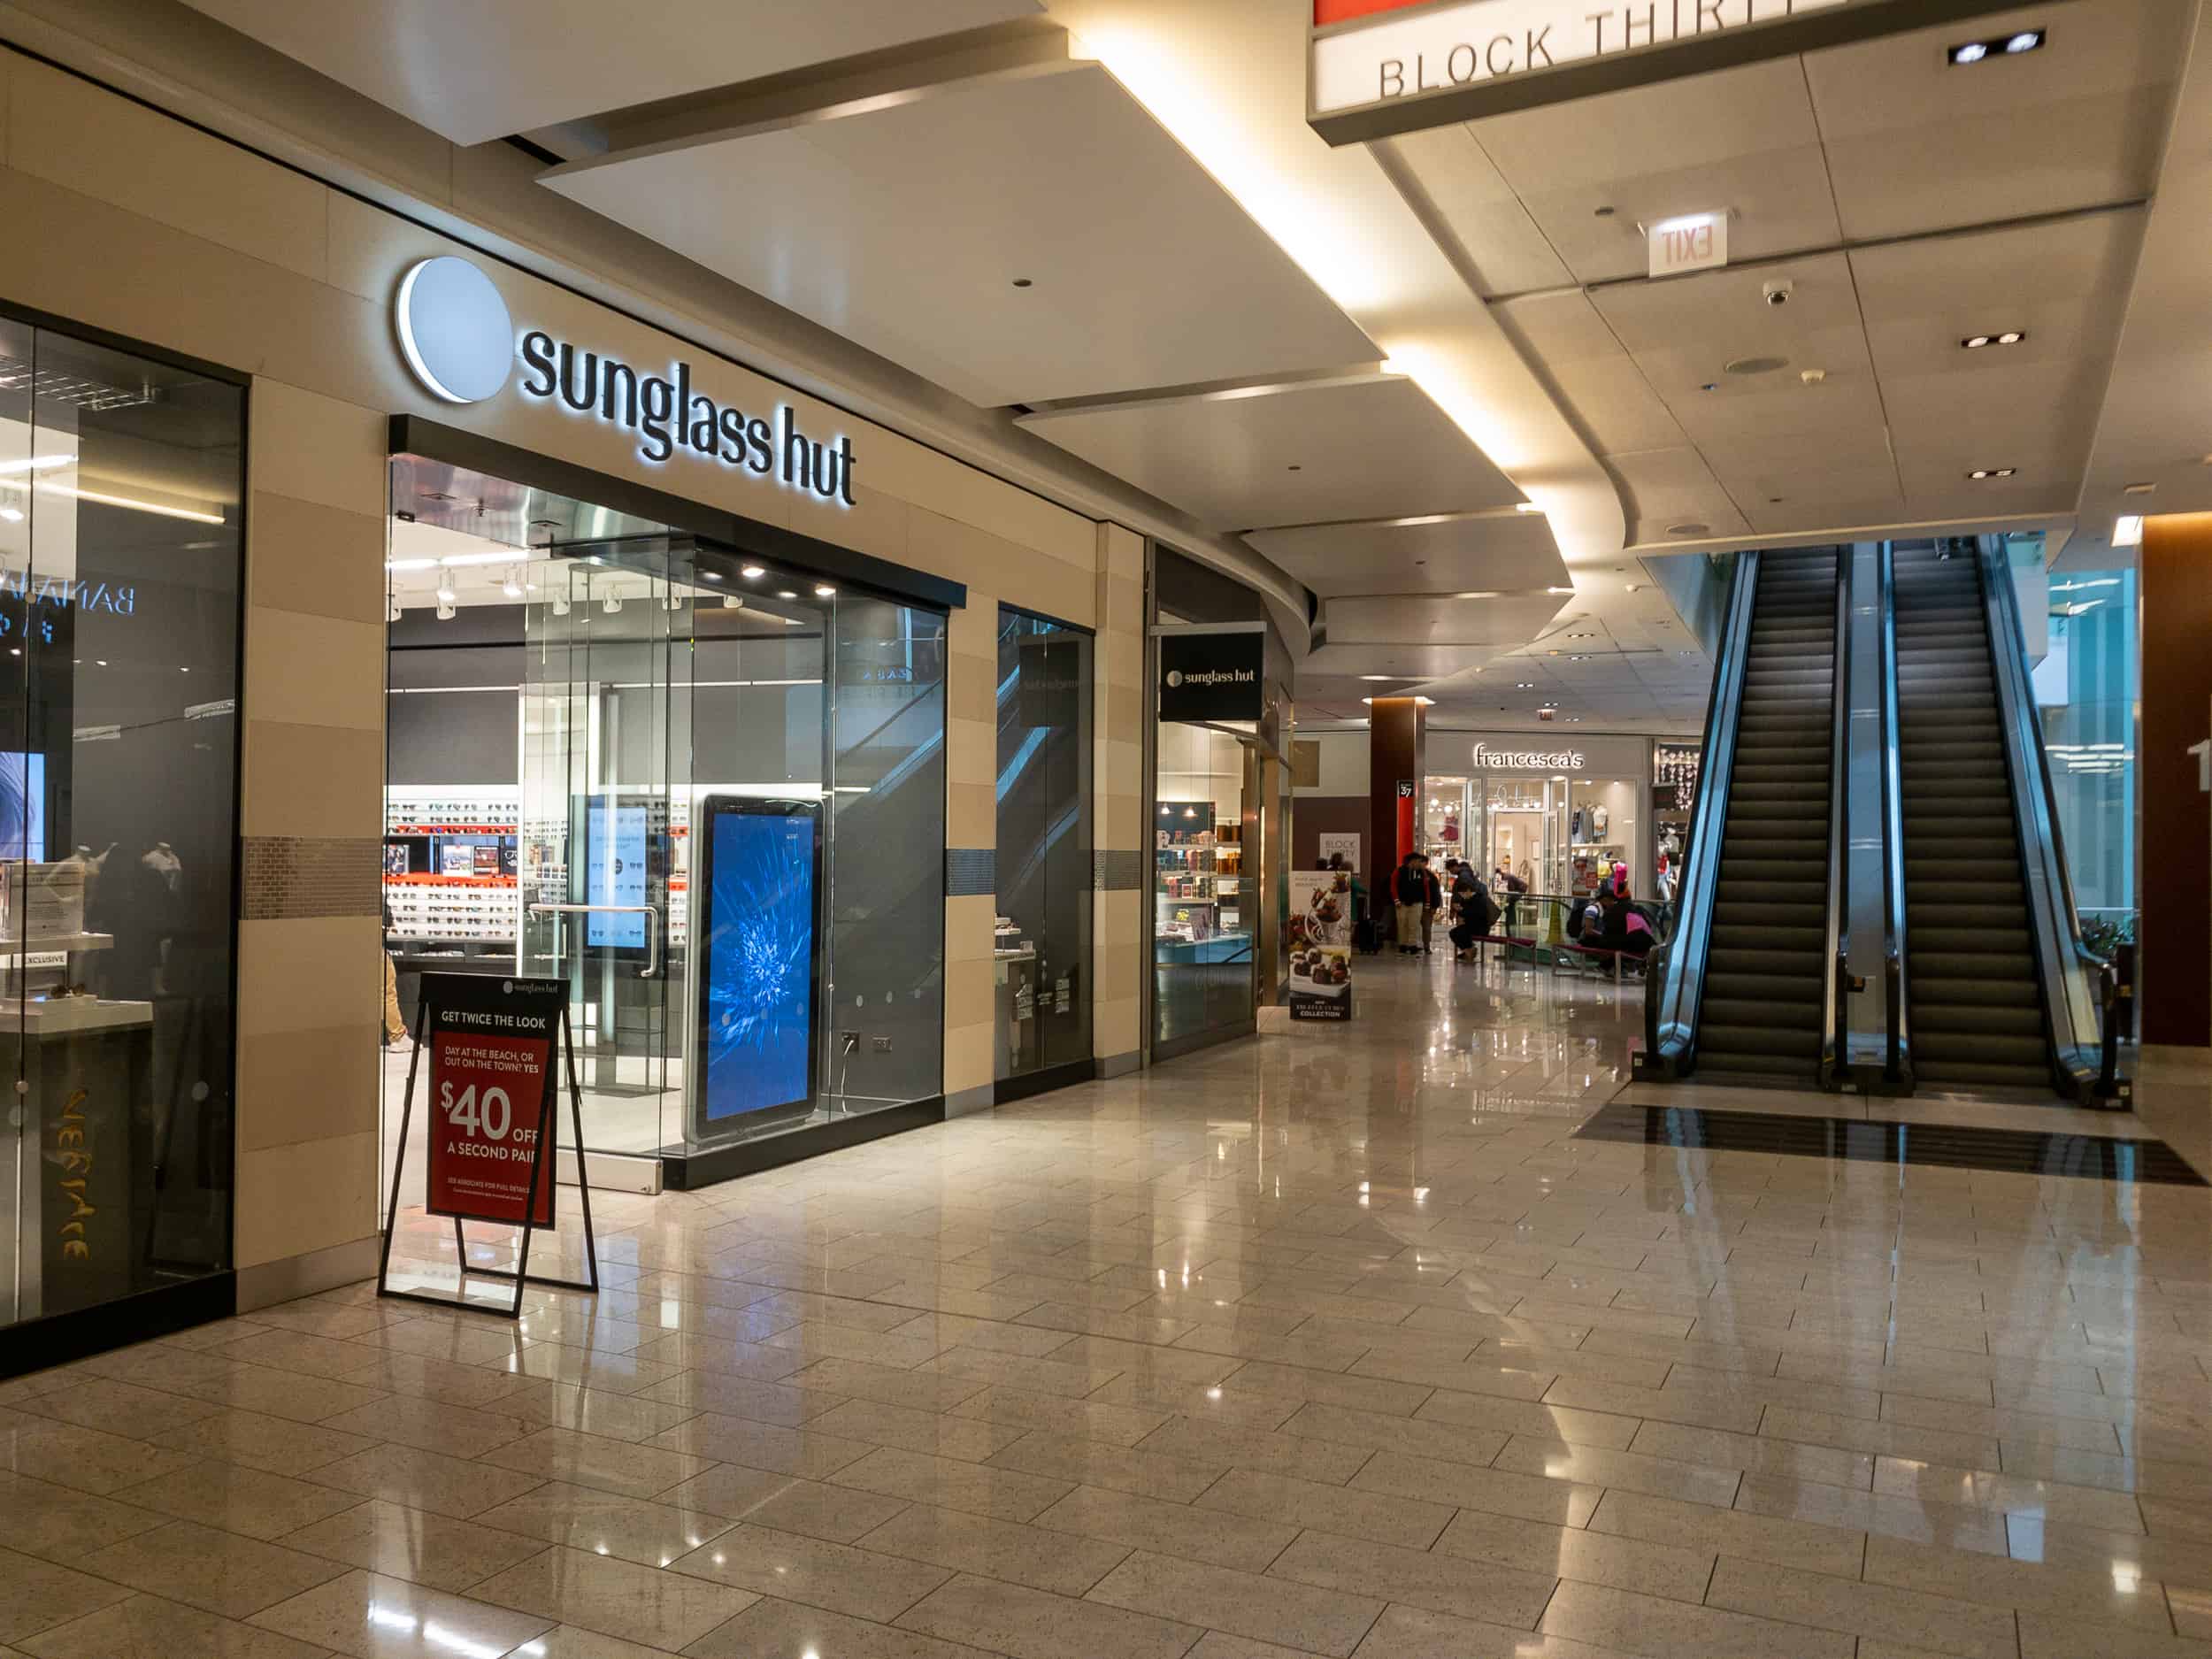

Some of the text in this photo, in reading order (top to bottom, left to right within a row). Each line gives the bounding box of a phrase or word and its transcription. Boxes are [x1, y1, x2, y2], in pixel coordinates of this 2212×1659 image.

[1379, 0, 1793, 100] BLOCK THIR
[522, 331, 857, 506] sunglass hut
[1185, 669, 1254, 687] sunglass hut
[1474, 743, 1585, 769] francesca's
[1401, 786, 1413, 798] 37
[27, 955, 65, 964] XCLUSIVE
[442, 1010, 546, 1029] GET TWICE THE LOOK
[445, 1046, 534, 1063] DAY AT THE BEACH, OR
[445, 1057, 539, 1074] OUT ON THE TOWN? YES
[441, 1080, 511, 1141] $40
[447, 1141, 457, 1155] A
[458, 1142, 508, 1160] SECOND
